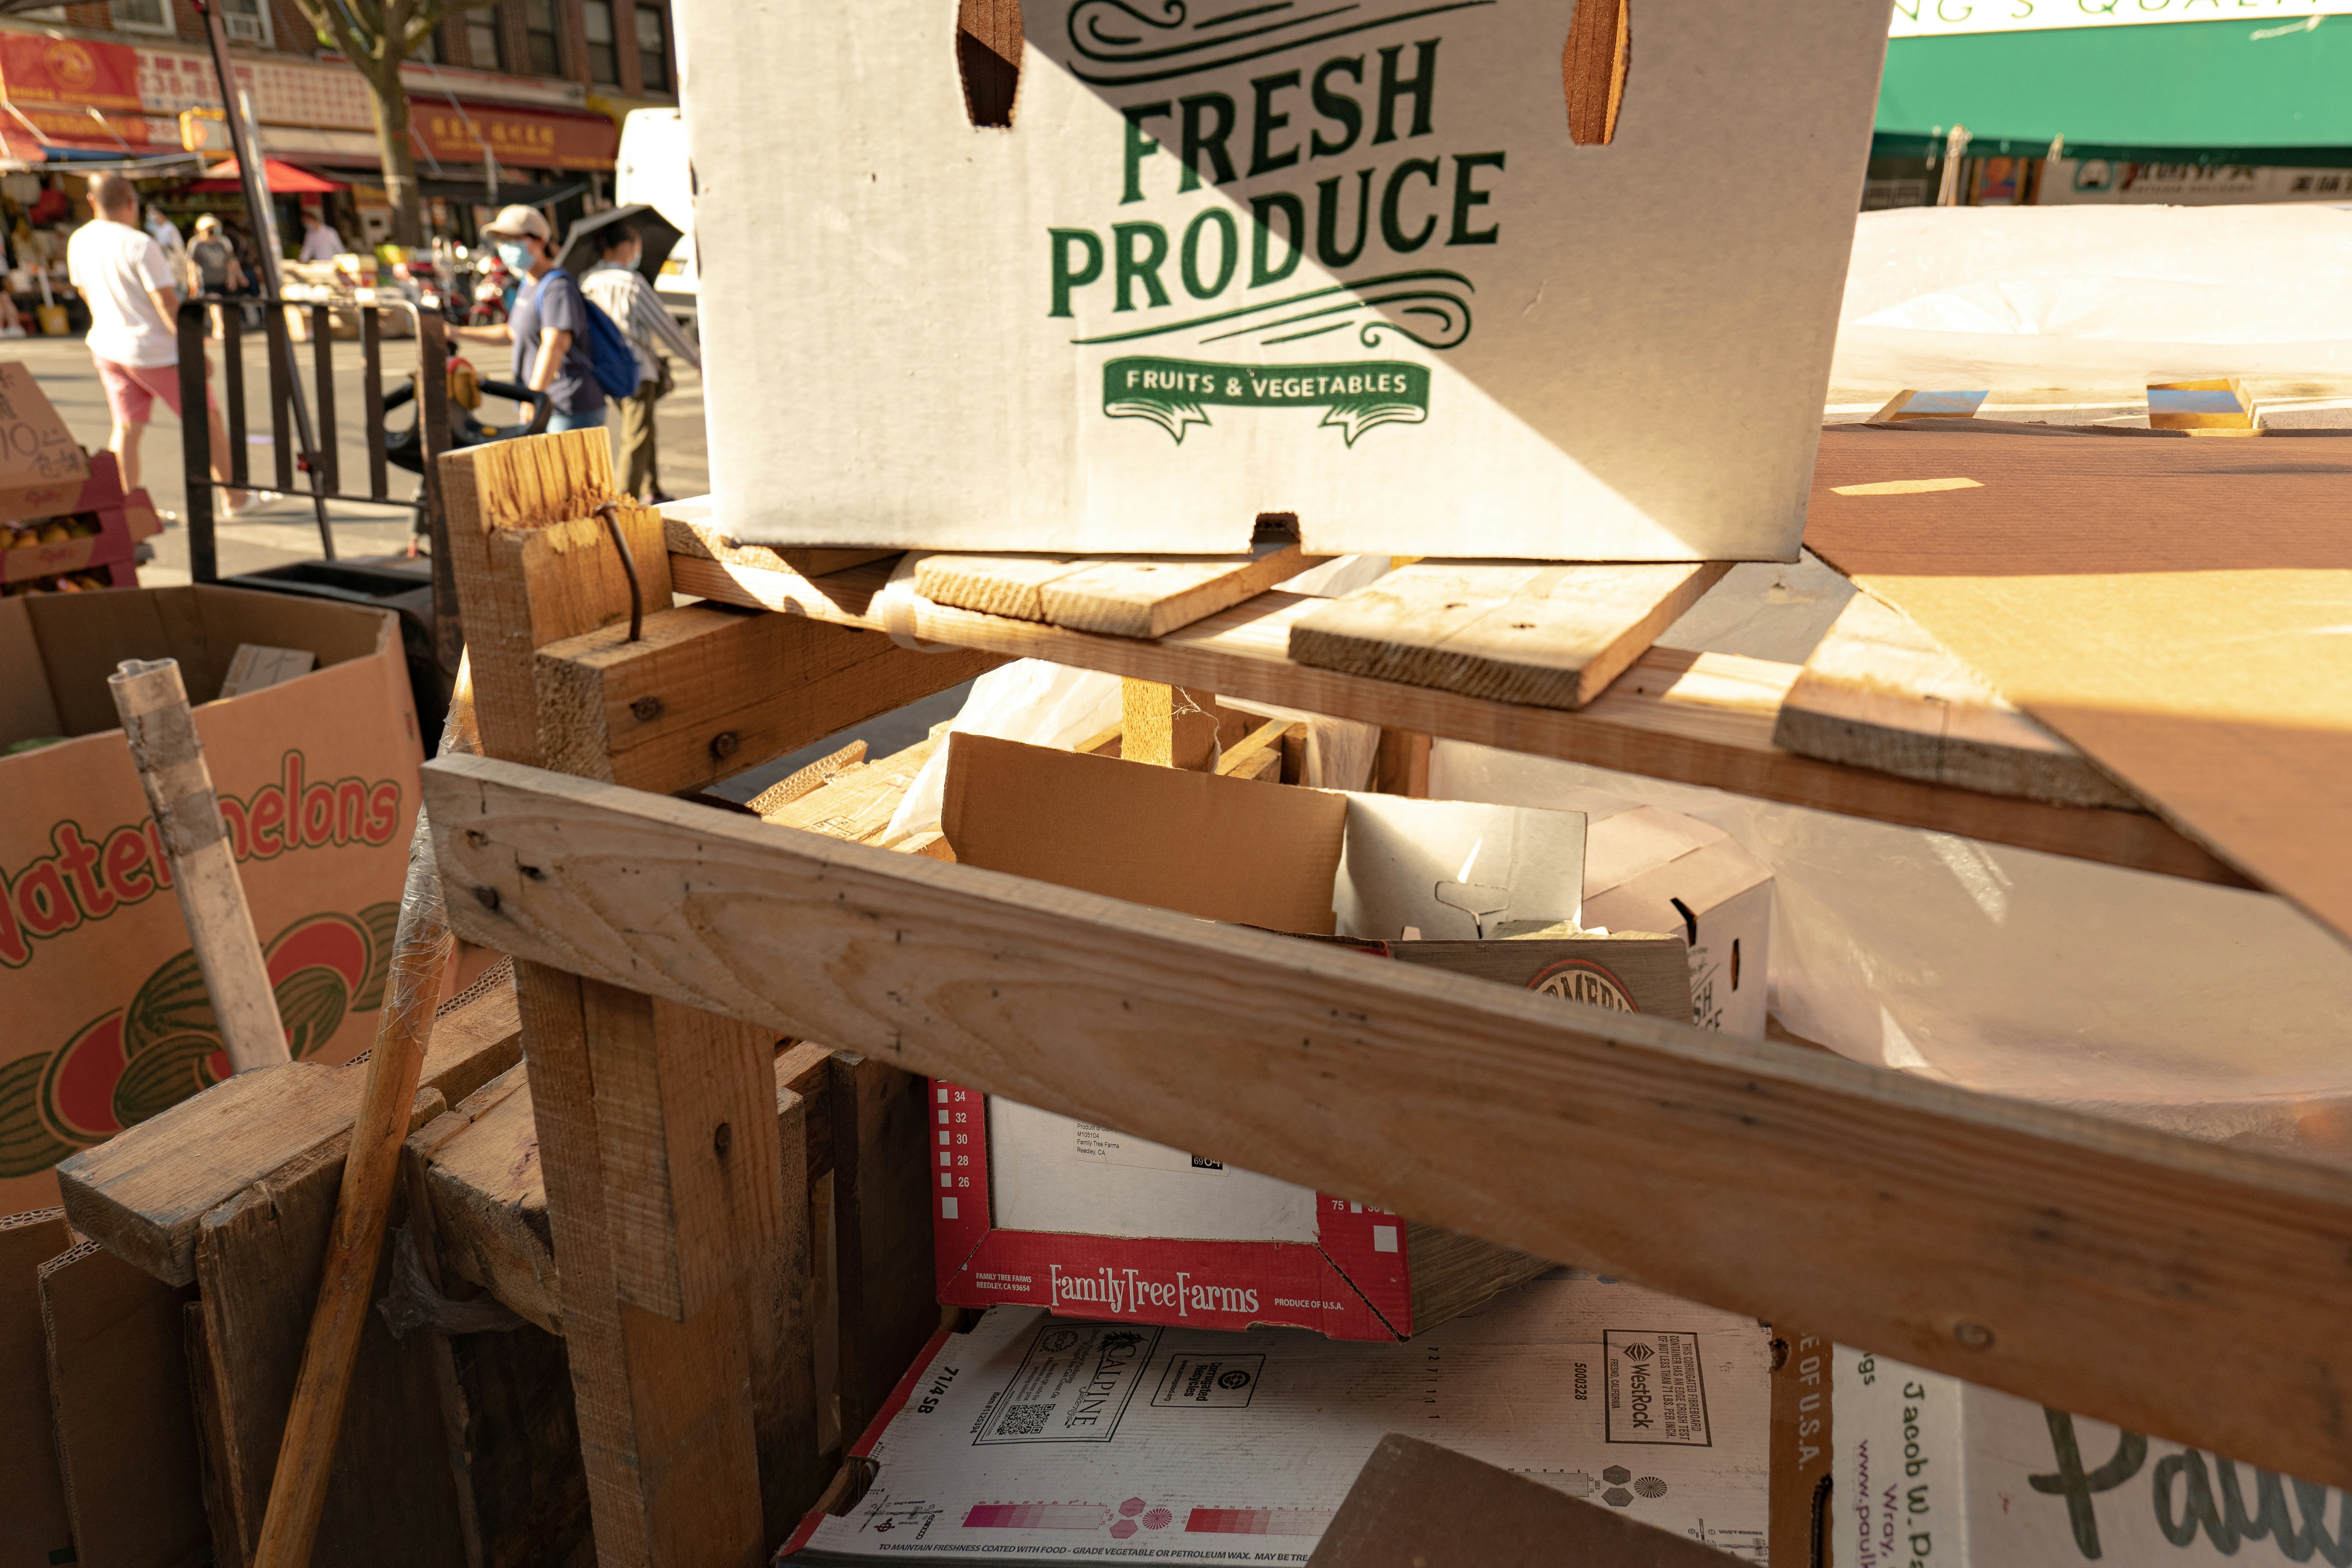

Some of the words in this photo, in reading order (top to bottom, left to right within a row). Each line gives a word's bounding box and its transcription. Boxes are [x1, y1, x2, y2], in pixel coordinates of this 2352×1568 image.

[1119, 37, 1442, 206] FRESH
[1047, 151, 1506, 318] PRODUCE
[1127, 370, 1215, 393] FRUITS
[1226, 378, 1243, 396] &
[1252, 375, 1408, 398] VEGETABLES
[955, 1091, 965, 1102] 34
[956, 1112, 966, 1123] 32
[956, 1134, 967, 1144] 30
[957, 1156, 969, 1166] 28
[958, 1177, 969, 1187] 26
[1332, 1200, 1344, 1210] 75
[976, 1273, 996, 1281] FAMILY
[976, 1281, 1002, 1290] REEDLEY,
[1275, 1298, 1310, 1308] PRODUCE
[1311, 1300, 1321, 1309] OF
[1323, 1301, 1344, 1310] U.S.A.
[1073, 1346, 1084, 1360] People
[1080, 1344, 1093, 1361] Produce
[1659, 1344, 1668, 1354] NOT
[1670, 1336, 1681, 1364] CONTAINER
[1682, 1343, 1692, 1355] THIS
[1049, 1363, 1058, 1372] Scan
[1610, 1359, 1619, 1378] FRESNO,
[1660, 1356, 1670, 1368] LESS
[1063, 1368, 1072, 1377] Can
[1066, 1362, 1084, 1384] Packaging
[1661, 1370, 1671, 1384] THAN
[1673, 1366, 1682, 1376] HAS
[1684, 1357, 1697, 1392] CORRUGATED
[1799, 1356, 1820, 1386] OF
[1030, 1382, 1038, 1391] more
[1055, 1378, 1067, 1391] Count
[1071, 1344, 1136, 1426] CALPINE
[1164, 1360, 1189, 1401] www.corrugated.org
[1184, 1365, 1208, 1397] Recycles
[1195, 1362, 1223, 1401] Corrugated
[1574, 1362, 1587, 1401] 5000328
[987, 1392, 1001, 1405] Item
[1024, 1392, 1032, 1401] great
[1611, 1380, 1620, 1408] CALIFORNIA
[1630, 1364, 1653, 1428] WestRock
[1675, 1387, 1685, 1401] EDGE
[917, 1396, 939, 1414] SB
[1677, 1403, 1688, 1423] CRUSH
[1688, 1394, 1701, 1431] FIBREBOARD
[970, 1405, 996, 1434] #1125394
[1665, 1422, 1676, 1439] INCH.
[1679, 1425, 1690, 1441] TEST
[1799, 1393, 1820, 1470] U.S.A.
[1904, 1381, 1927, 1477] Jacob
[1907, 1485, 1930, 1526] W.
[1879, 1484, 1898, 1558] Wray,
[891, 1544, 932, 1552] MAINTAIN
[1105, 1548, 1155, 1557] VEGETABLE
[1172, 1550, 1225, 1559] PETROLEUM
[1227, 1552, 1251, 1560] WAX.
